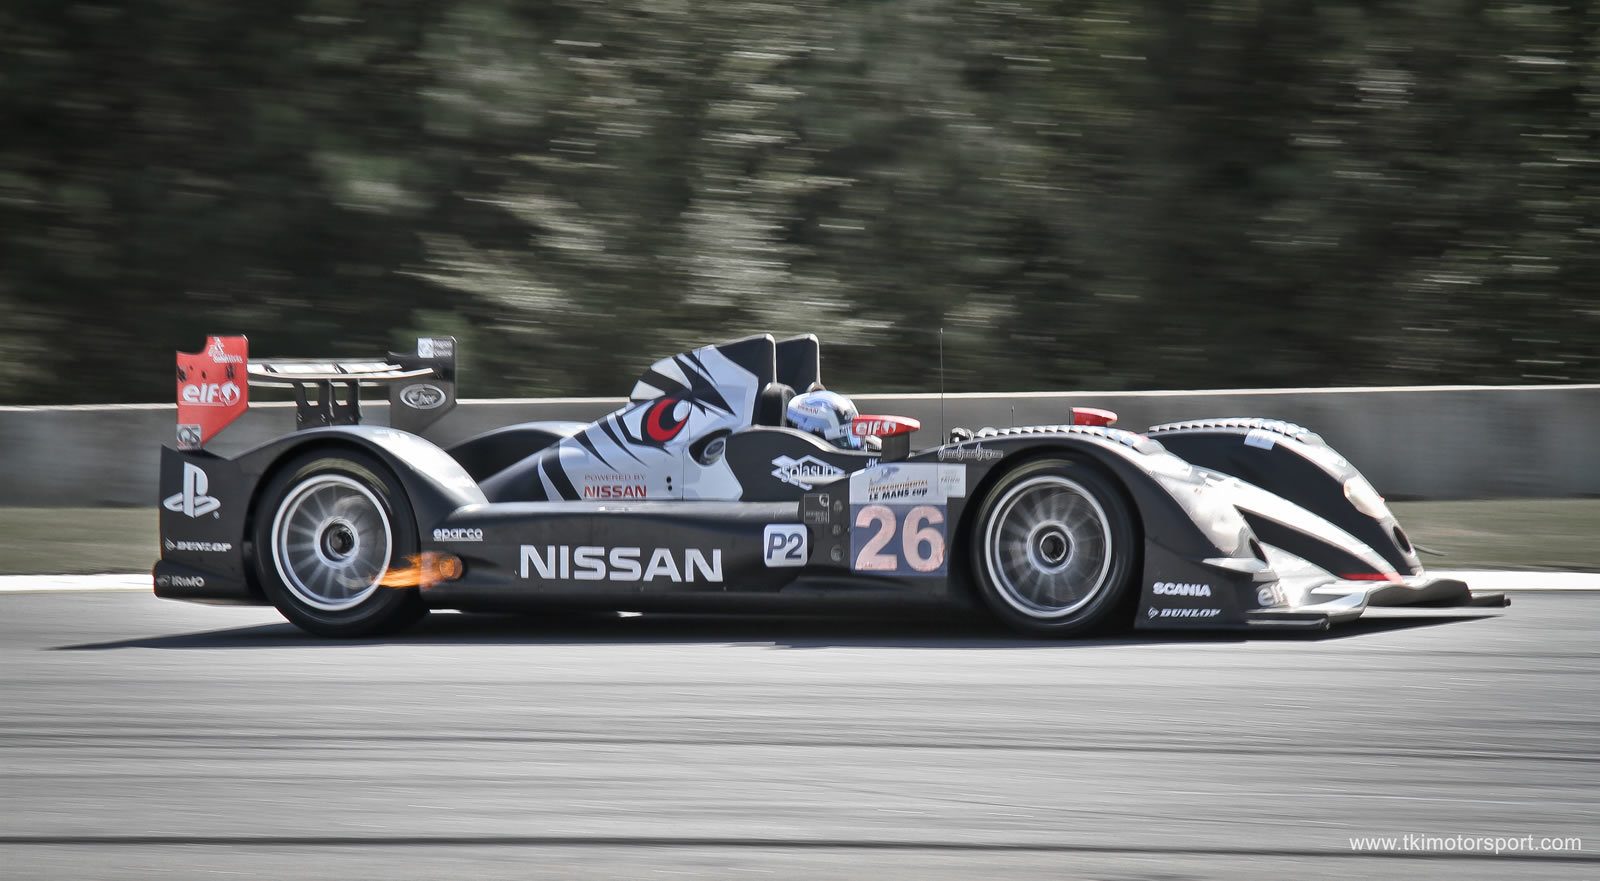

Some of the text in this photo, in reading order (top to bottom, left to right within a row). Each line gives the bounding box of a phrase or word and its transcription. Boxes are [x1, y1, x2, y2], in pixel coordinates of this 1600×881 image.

[183, 383, 220, 403] elf
[584, 486, 647, 498] NISSAN
[869, 492, 879, 502] LE
[881, 489, 910, 500] MANS
[855, 505, 945, 572] 26
[176, 541, 233, 552] DUNLOP
[767, 532, 804, 561] P2
[520, 545, 723, 583] NISSAN
[1153, 582, 1212, 597] SCANIA
[1160, 608, 1221, 618] DUNLOP
